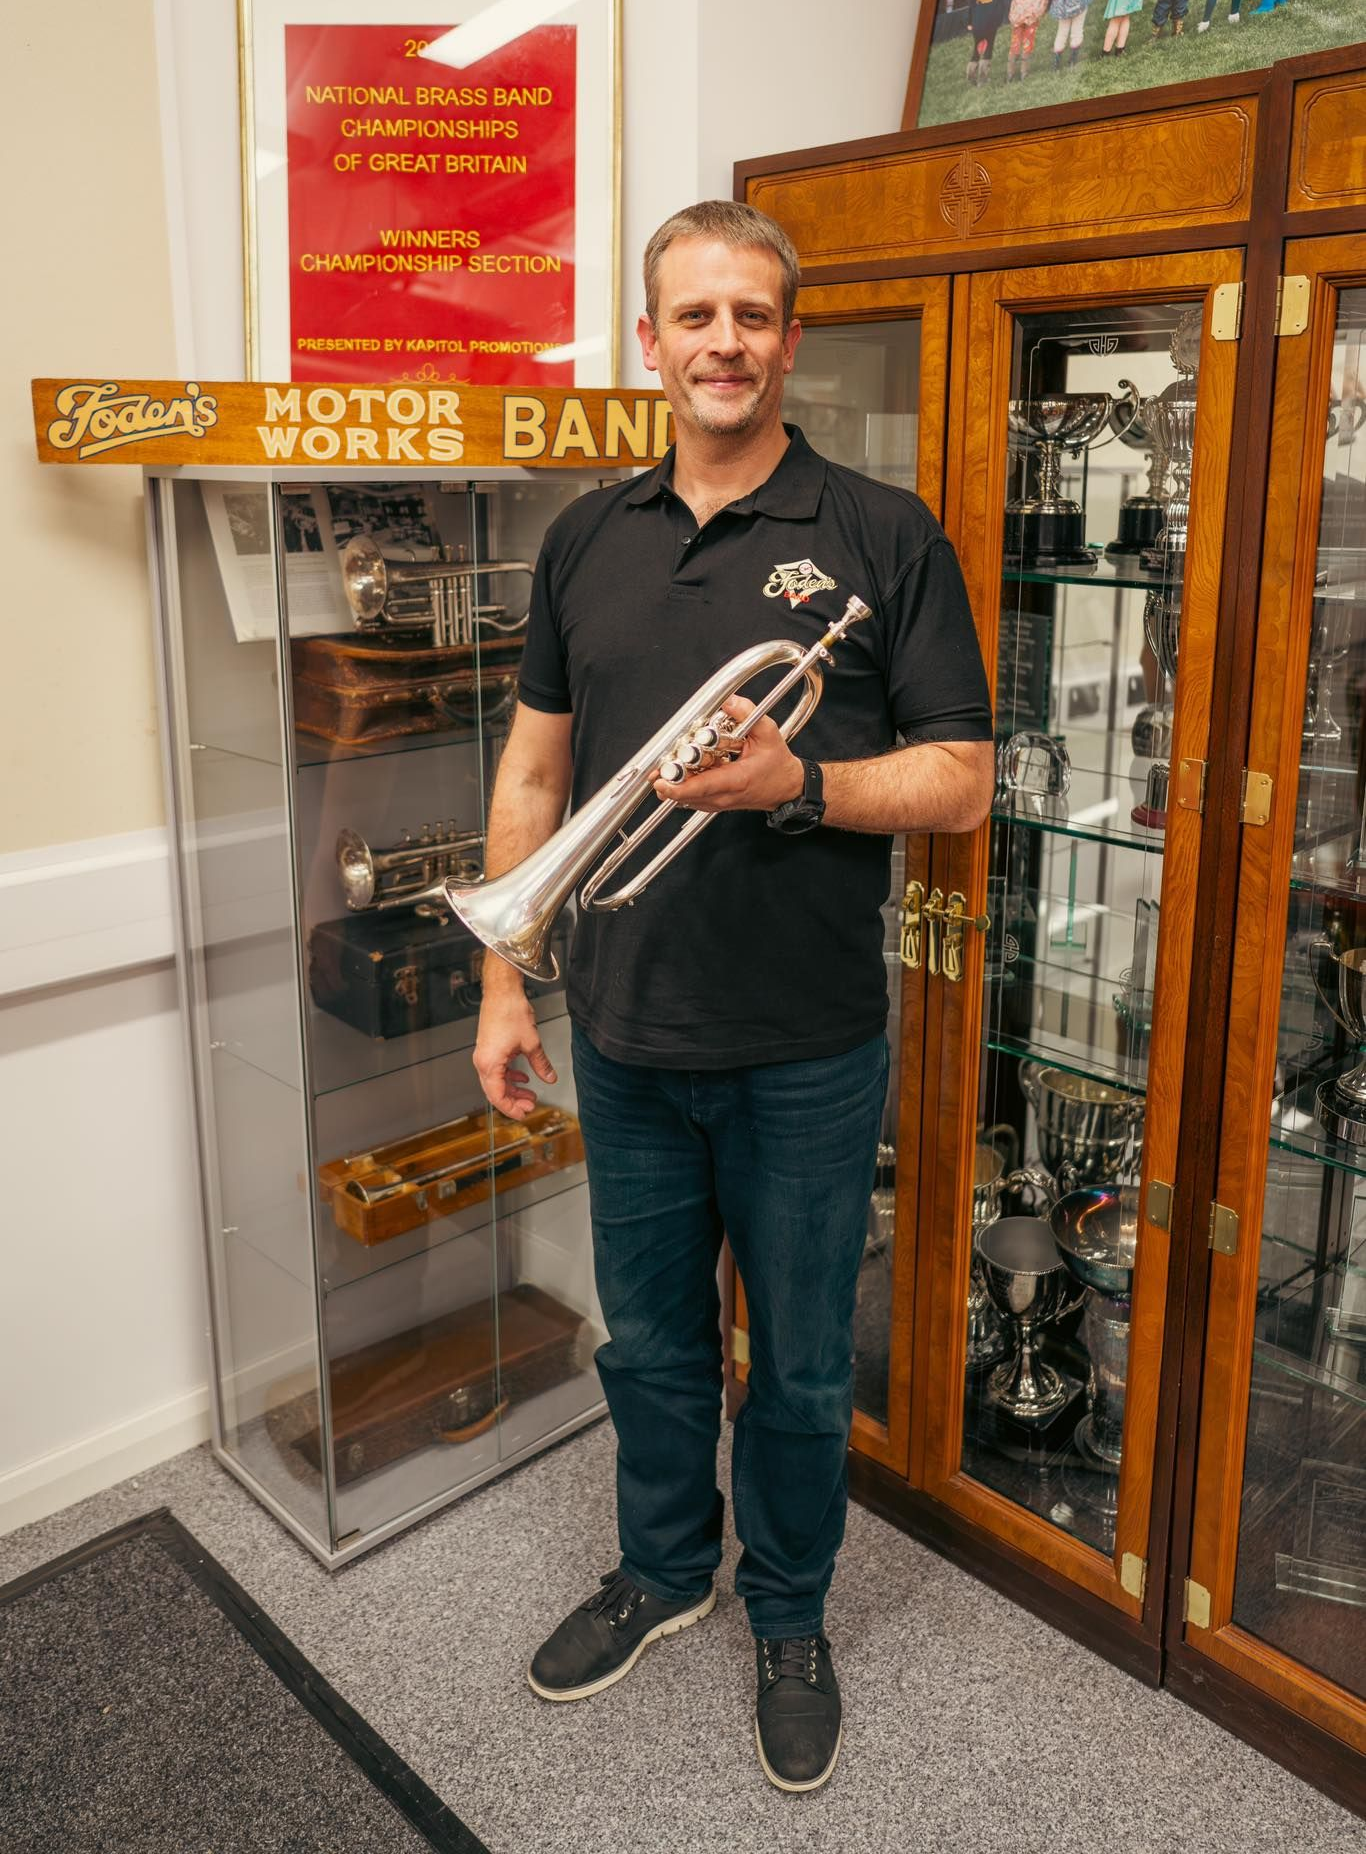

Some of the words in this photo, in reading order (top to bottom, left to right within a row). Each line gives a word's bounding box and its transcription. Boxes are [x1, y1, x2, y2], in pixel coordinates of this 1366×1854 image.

[305, 85, 411, 106] NATIONAL
[415, 86, 488, 107] BRASS
[493, 87, 553, 107] BAND
[340, 118, 519, 140] CHAMPIONSHIPS
[333, 153, 362, 172] OF
[368, 153, 440, 173] GREAT
[445, 155, 527, 174] BRITAIN
[379, 229, 480, 249] WINNERS
[299, 254, 462, 274] CHAMPIONSHIP
[467, 255, 561, 274] SECTION
[297, 338, 380, 352] PRESENTED
[385, 340, 403, 352] BY
[406, 340, 467, 353] KAPITOL
[264, 387, 463, 425] MOTOR
[48, 382, 217, 460] Foden's
[256, 426, 464, 462] WORKS
